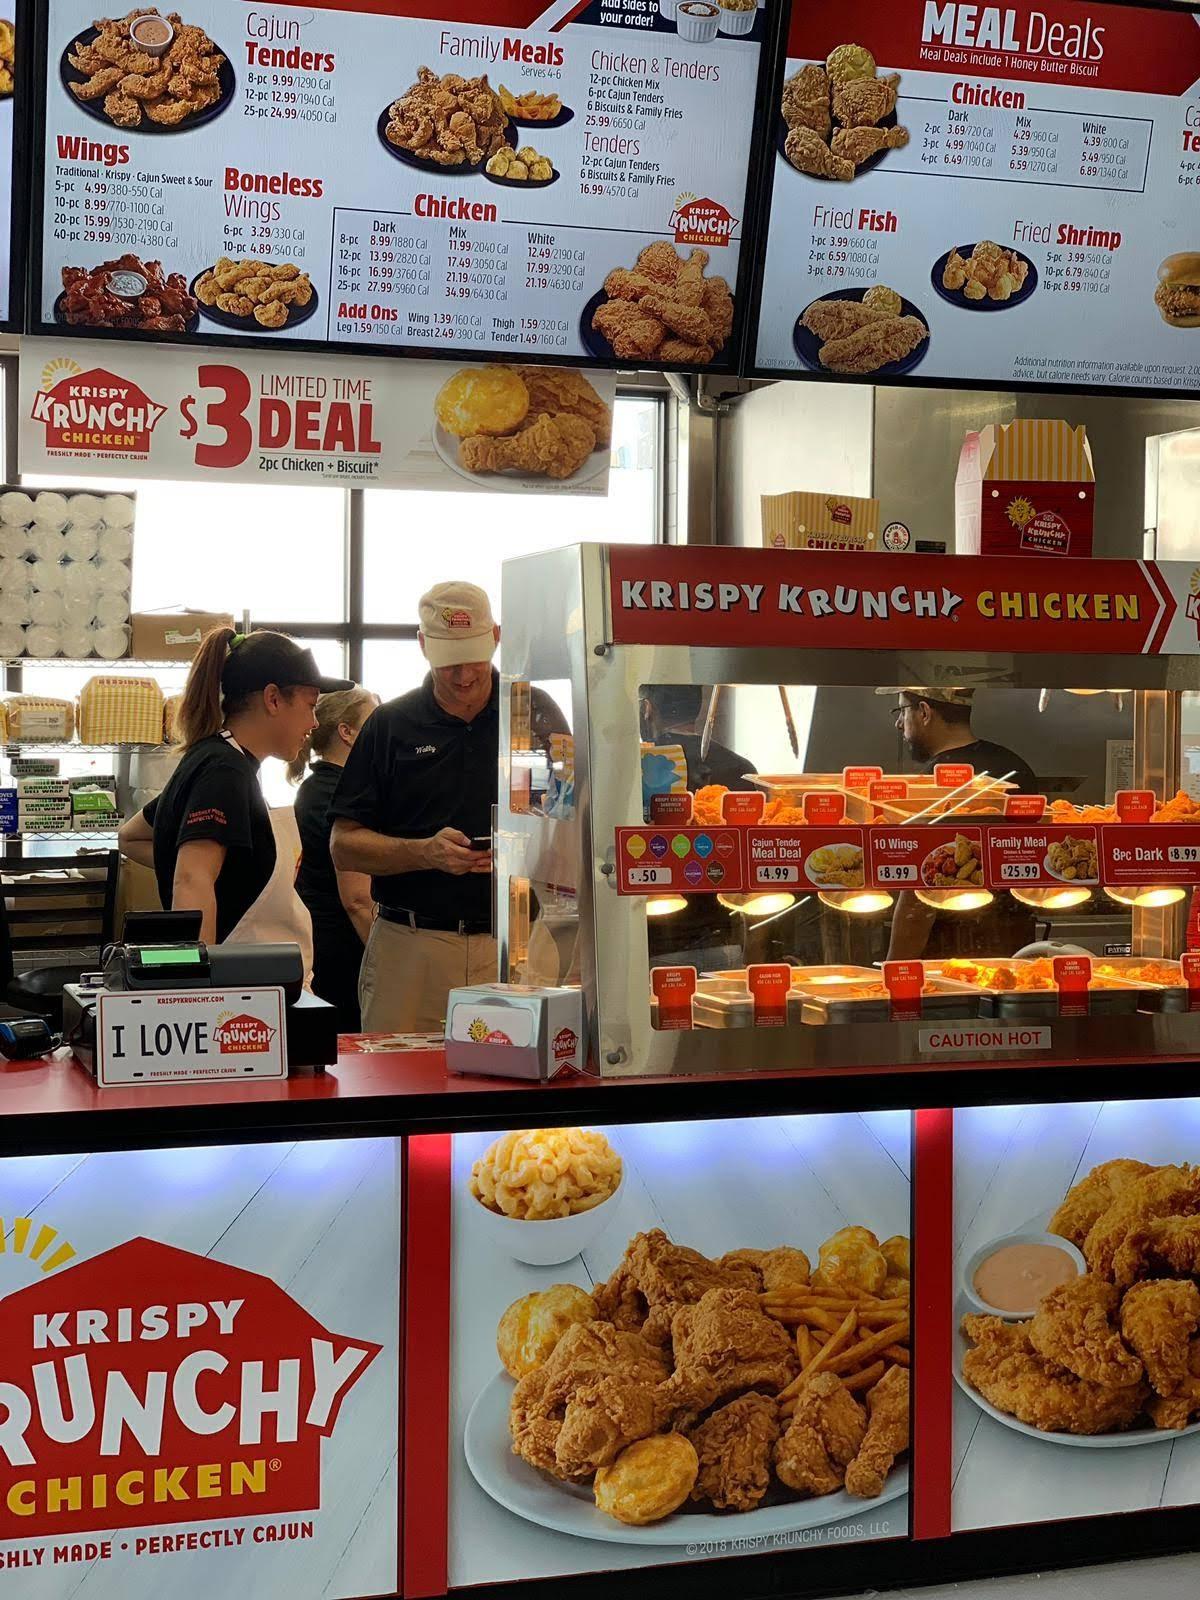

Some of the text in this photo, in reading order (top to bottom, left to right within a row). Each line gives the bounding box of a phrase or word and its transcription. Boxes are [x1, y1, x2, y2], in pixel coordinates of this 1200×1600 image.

[621, 0, 646, 12] sides
[649, 0, 658, 12] to
[247, 12, 300, 41] Cajun
[600, 12, 653, 27] your order!
[921, 0, 1105, 60] MEAL Deals
[440, 31, 564, 65] Family Meals
[245, 41, 335, 72] Tenders
[919, 48, 1098, 76] Meal Deals include 1 Honey Butter Biscuit
[521, 65, 561, 79] Serves 4-6
[591, 50, 720, 81] Chicken & Tenders
[247, 72, 267, 85] 8-pc
[318, 79, 331, 90] Cal
[589, 73, 659, 89] 12-pc Chicken Mix
[245, 88, 268, 101] 12-pc
[322, 95, 334, 106] Cal
[588, 87, 664, 103] 6-pc Cajun Tenders
[951, 81, 1025, 109] Chicken
[244, 104, 268, 118] 25-pc
[324, 111, 336, 122] Cal
[587, 101, 682, 119] 6 Biscuits & Family Fries
[948, 109, 968, 122] Dark
[924, 122, 940, 134] 2-pc
[1015, 116, 1031, 127] Mix
[1082, 122, 1106, 135] White
[56, 135, 129, 166] Wings
[583, 131, 640, 155] Tenders
[55, 165, 213, 187] Traditional Krispy Cajun Sweet & Sour
[224, 167, 323, 198] Boneless
[223, 193, 280, 223] Wings
[414, 193, 496, 221] Chicken
[689, 207, 720, 216] KRISPY
[54, 213, 79, 226] 20-pc
[373, 220, 396, 233] Dark
[669, 211, 739, 235] KRUNCHY
[813, 205, 897, 232] Fried Fish
[223, 224, 242, 236] 6-pc
[449, 226, 466, 238] Mix
[1013, 220, 1121, 251] Fried Shrimp
[527, 232, 555, 245] White
[683, 234, 721, 243] CHICKEN
[810, 235, 826, 246] 1-pc
[337, 302, 398, 321] Add Ons
[69, 385, 128, 399] KRISPY
[260, 374, 371, 400] LIMITED TIME
[33, 393, 165, 432] KRUNCHY
[179, 364, 252, 468] $3
[258, 398, 381, 453] DEAL
[62, 432, 135, 445] CHICKEN
[259, 456, 278, 471] 2pc
[281, 457, 323, 471] Chicken
[327, 462, 333, 470] +
[1034, 519, 1061, 529] KRISPY
[1027, 527, 1065, 539] KRUNCHY
[1028, 536, 1062, 546] CHICKEN
[621, 580, 1139, 619] KRISPY KRUNCHY CHICKEN
[751, 838, 801, 847] Cajun Tender
[873, 838, 918, 851] 10 Wings
[990, 836, 1047, 850] Family Meal
[751, 847, 801, 858] Meal Deal
[1135, 847, 1163, 861] Dark
[759, 867, 789, 880] $4.99
[879, 866, 909, 879] $8.99
[1003, 865, 1037, 878] $25.99
[157, 995, 224, 1004] KRISPYKRUNCHY.COM
[111, 1022, 208, 1057] I LOVE
[214, 1027, 275, 1044] KRUNCHY
[929, 1031, 1041, 1047] CAUTION HOT
[32, 1298, 244, 1349] KRISPY
[0, 1337, 368, 1466] RUNCHY
[731, 1535, 769, 1550] KRISPY
[772, 1529, 823, 1545] KRUNCHY
[827, 1524, 866, 1539] FOODS,
[870, 1521, 889, 1534] LLC
[0, 1521, 313, 1569] SHLY MADE PERFECTLY CAJUN
